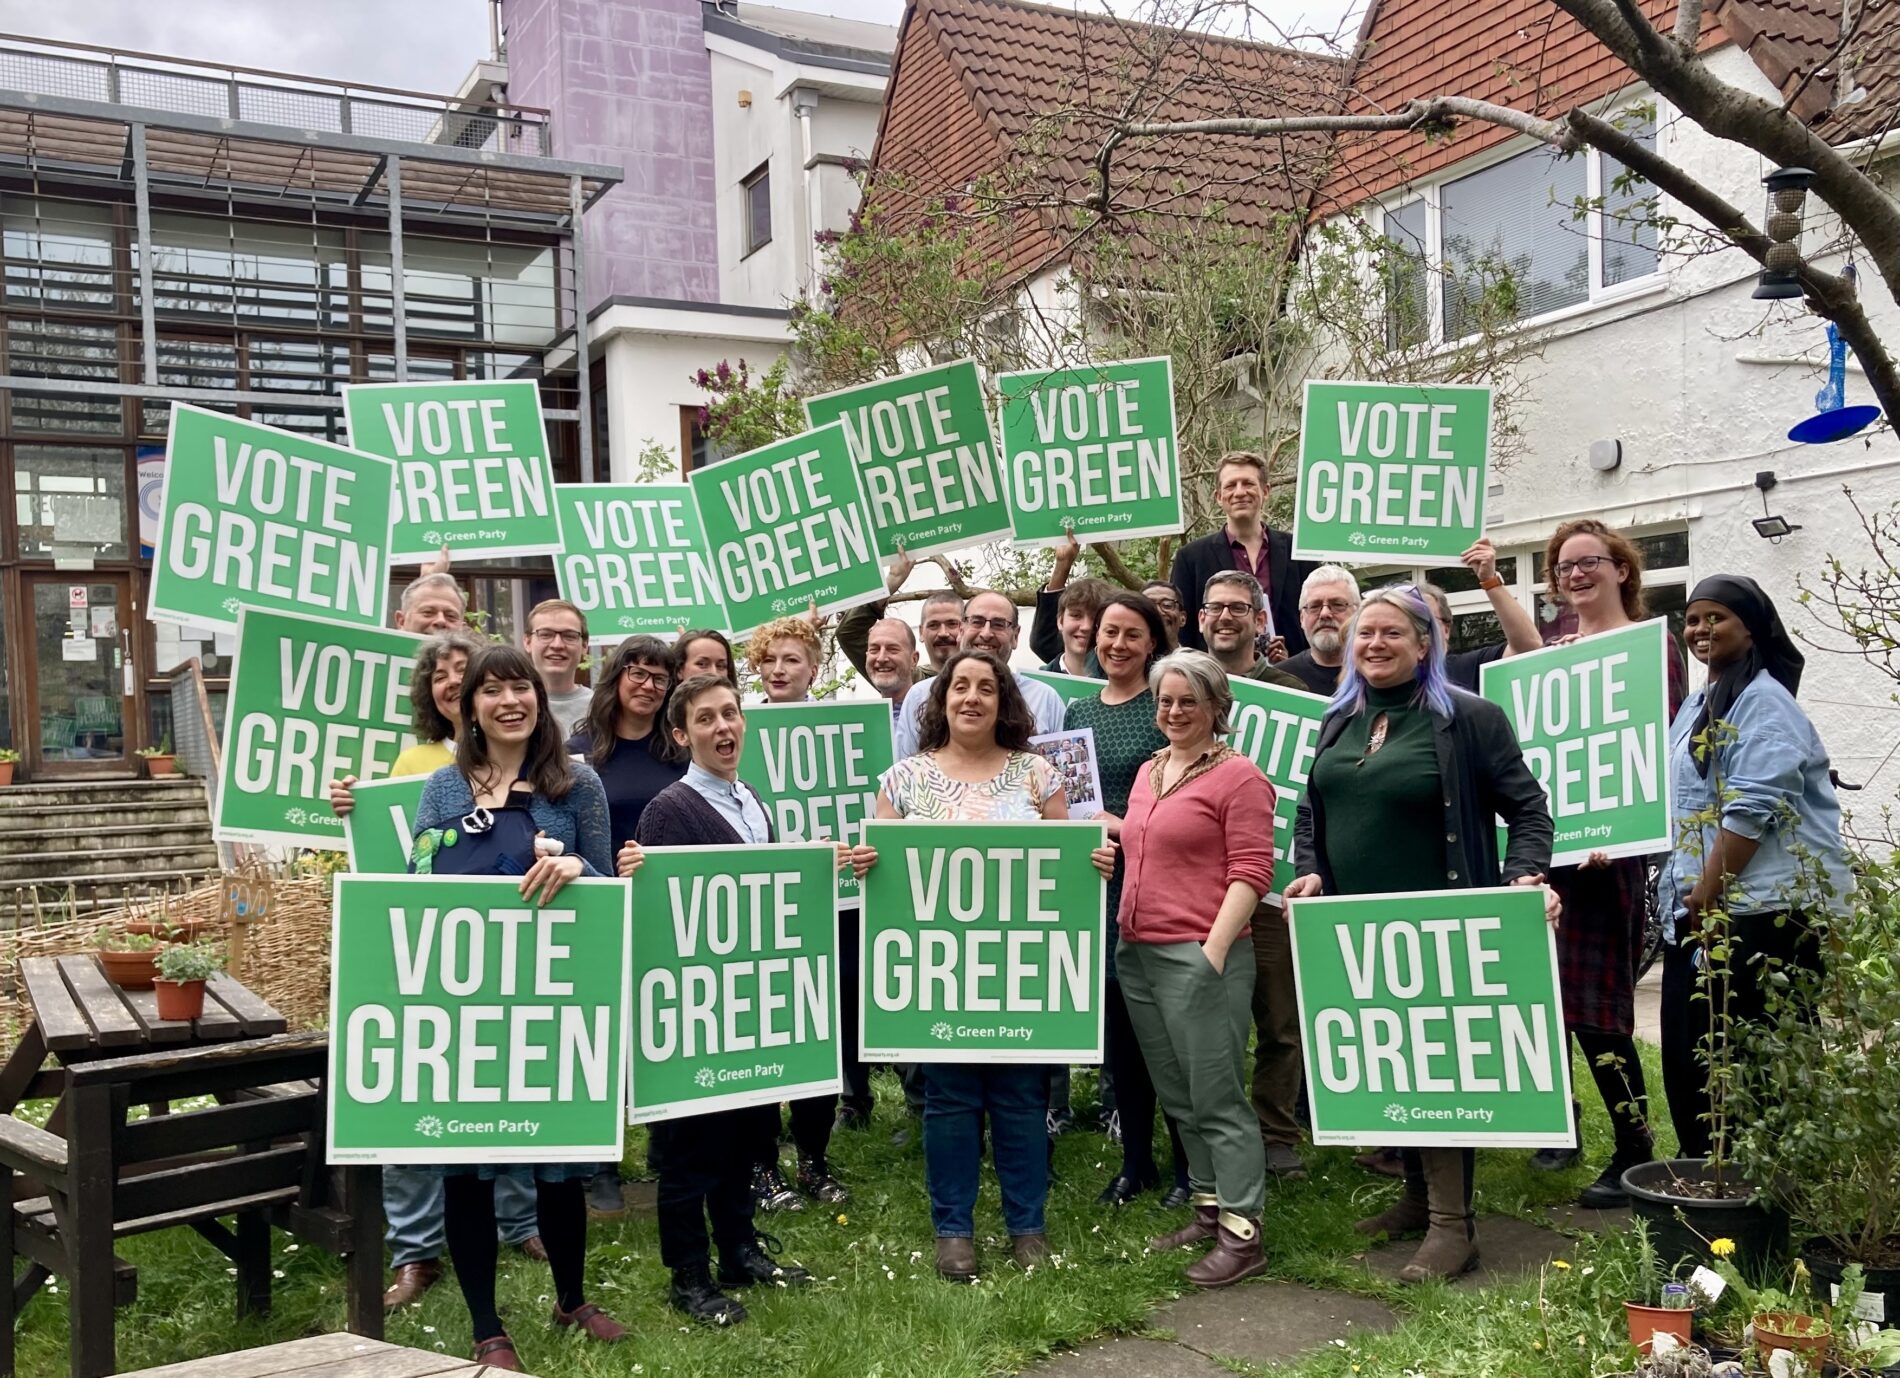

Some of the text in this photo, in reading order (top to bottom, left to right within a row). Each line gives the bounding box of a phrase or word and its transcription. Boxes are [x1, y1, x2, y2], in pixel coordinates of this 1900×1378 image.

[381, 399, 513, 457] VOTE
[839, 385, 960, 465] VOTE
[1029, 379, 1144, 444] VOTE
[1337, 401, 1458, 460] VOTE
[139, 471, 164, 479] Welco
[213, 435, 356, 534] VOTE
[392, 456, 549, 525] REEN
[719, 450, 832, 532] VOTE
[864, 441, 998, 529] REEN
[1013, 437, 1171, 512] GREEN
[1305, 460, 1478, 528] GREEN
[444, 529, 507, 542] Green Party
[574, 500, 691, 549] VOTE
[718, 502, 871, 603] GREEN
[908, 522, 963, 541] Green Party
[1077, 512, 1132, 526] Green Party
[1368, 535, 1429, 548] Green Party
[169, 502, 378, 617] GREEN
[564, 552, 723, 611] GREEN
[636, 616, 691, 626] Green Party
[787, 585, 838, 608] Green Party
[279, 637, 418, 726] VOTE
[1511, 652, 1629, 743] VOTE
[758, 723, 869, 793] VOTE
[1520, 722, 1658, 819] REEN
[309, 813, 345, 827] Green
[762, 791, 876, 850] REE
[1553, 823, 1612, 843] Green Party
[667, 872, 801, 958] VOTE
[905, 847, 1061, 922] VOTE
[389, 907, 577, 997] VOTE
[872, 928, 1091, 1012] GREEN
[1334, 917, 1508, 1000] VOTE
[639, 954, 829, 1063] GREEN
[956, 1025, 1033, 1040] Green Party
[345, 1004, 610, 1104] GREEN
[717, 1062, 784, 1082] Green Party
[1314, 1003, 1554, 1094] GREEN
[447, 1119, 540, 1136] Green Party
[1410, 1108, 1494, 1122] Green Party
